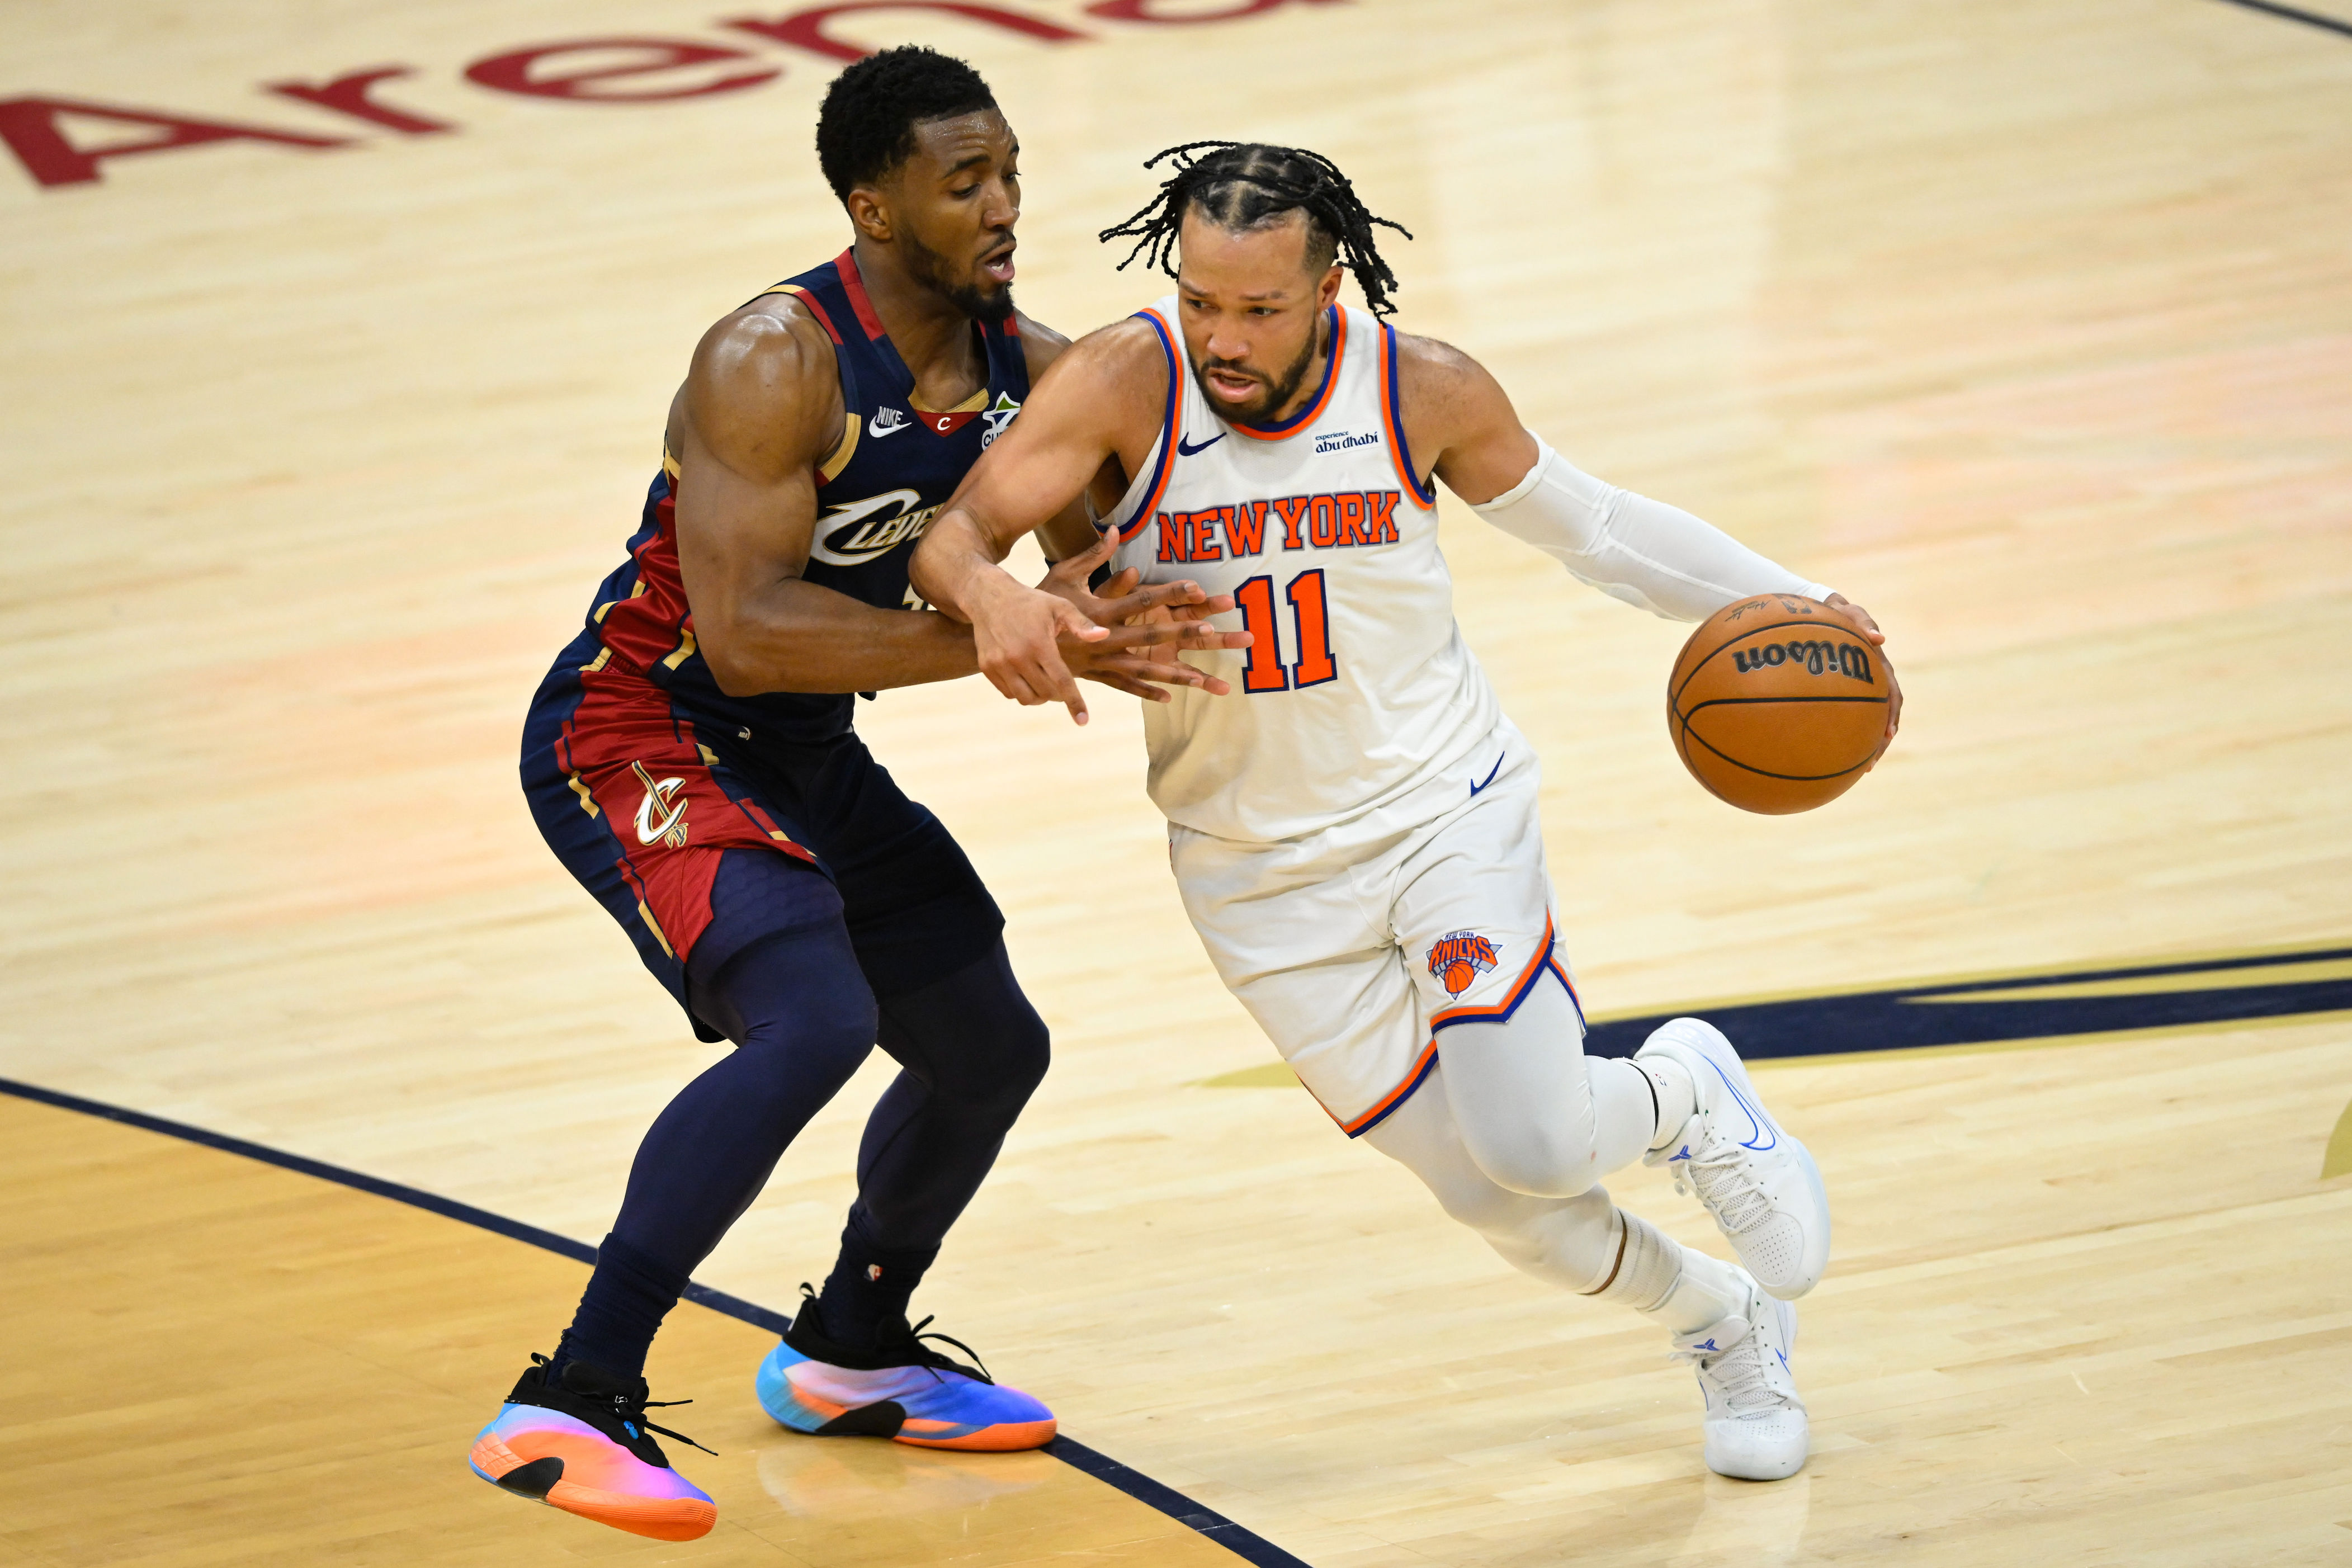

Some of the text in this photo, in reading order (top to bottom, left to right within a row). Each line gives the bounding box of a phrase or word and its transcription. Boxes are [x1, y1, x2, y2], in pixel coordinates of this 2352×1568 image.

[876, 406, 903, 427] NIKE
[937, 417, 951, 431] C
[1315, 431, 1349, 441] experience
[1315, 441, 1341, 453] abu
[810, 488, 946, 566] CLEVE
[1156, 490, 1401, 564] NEW YORK
[1234, 568, 1338, 695] 11
[1731, 640, 1874, 684] Wilson
[1444, 932, 1458, 941] NEW
[1428, 935, 1499, 972] KNICKS
